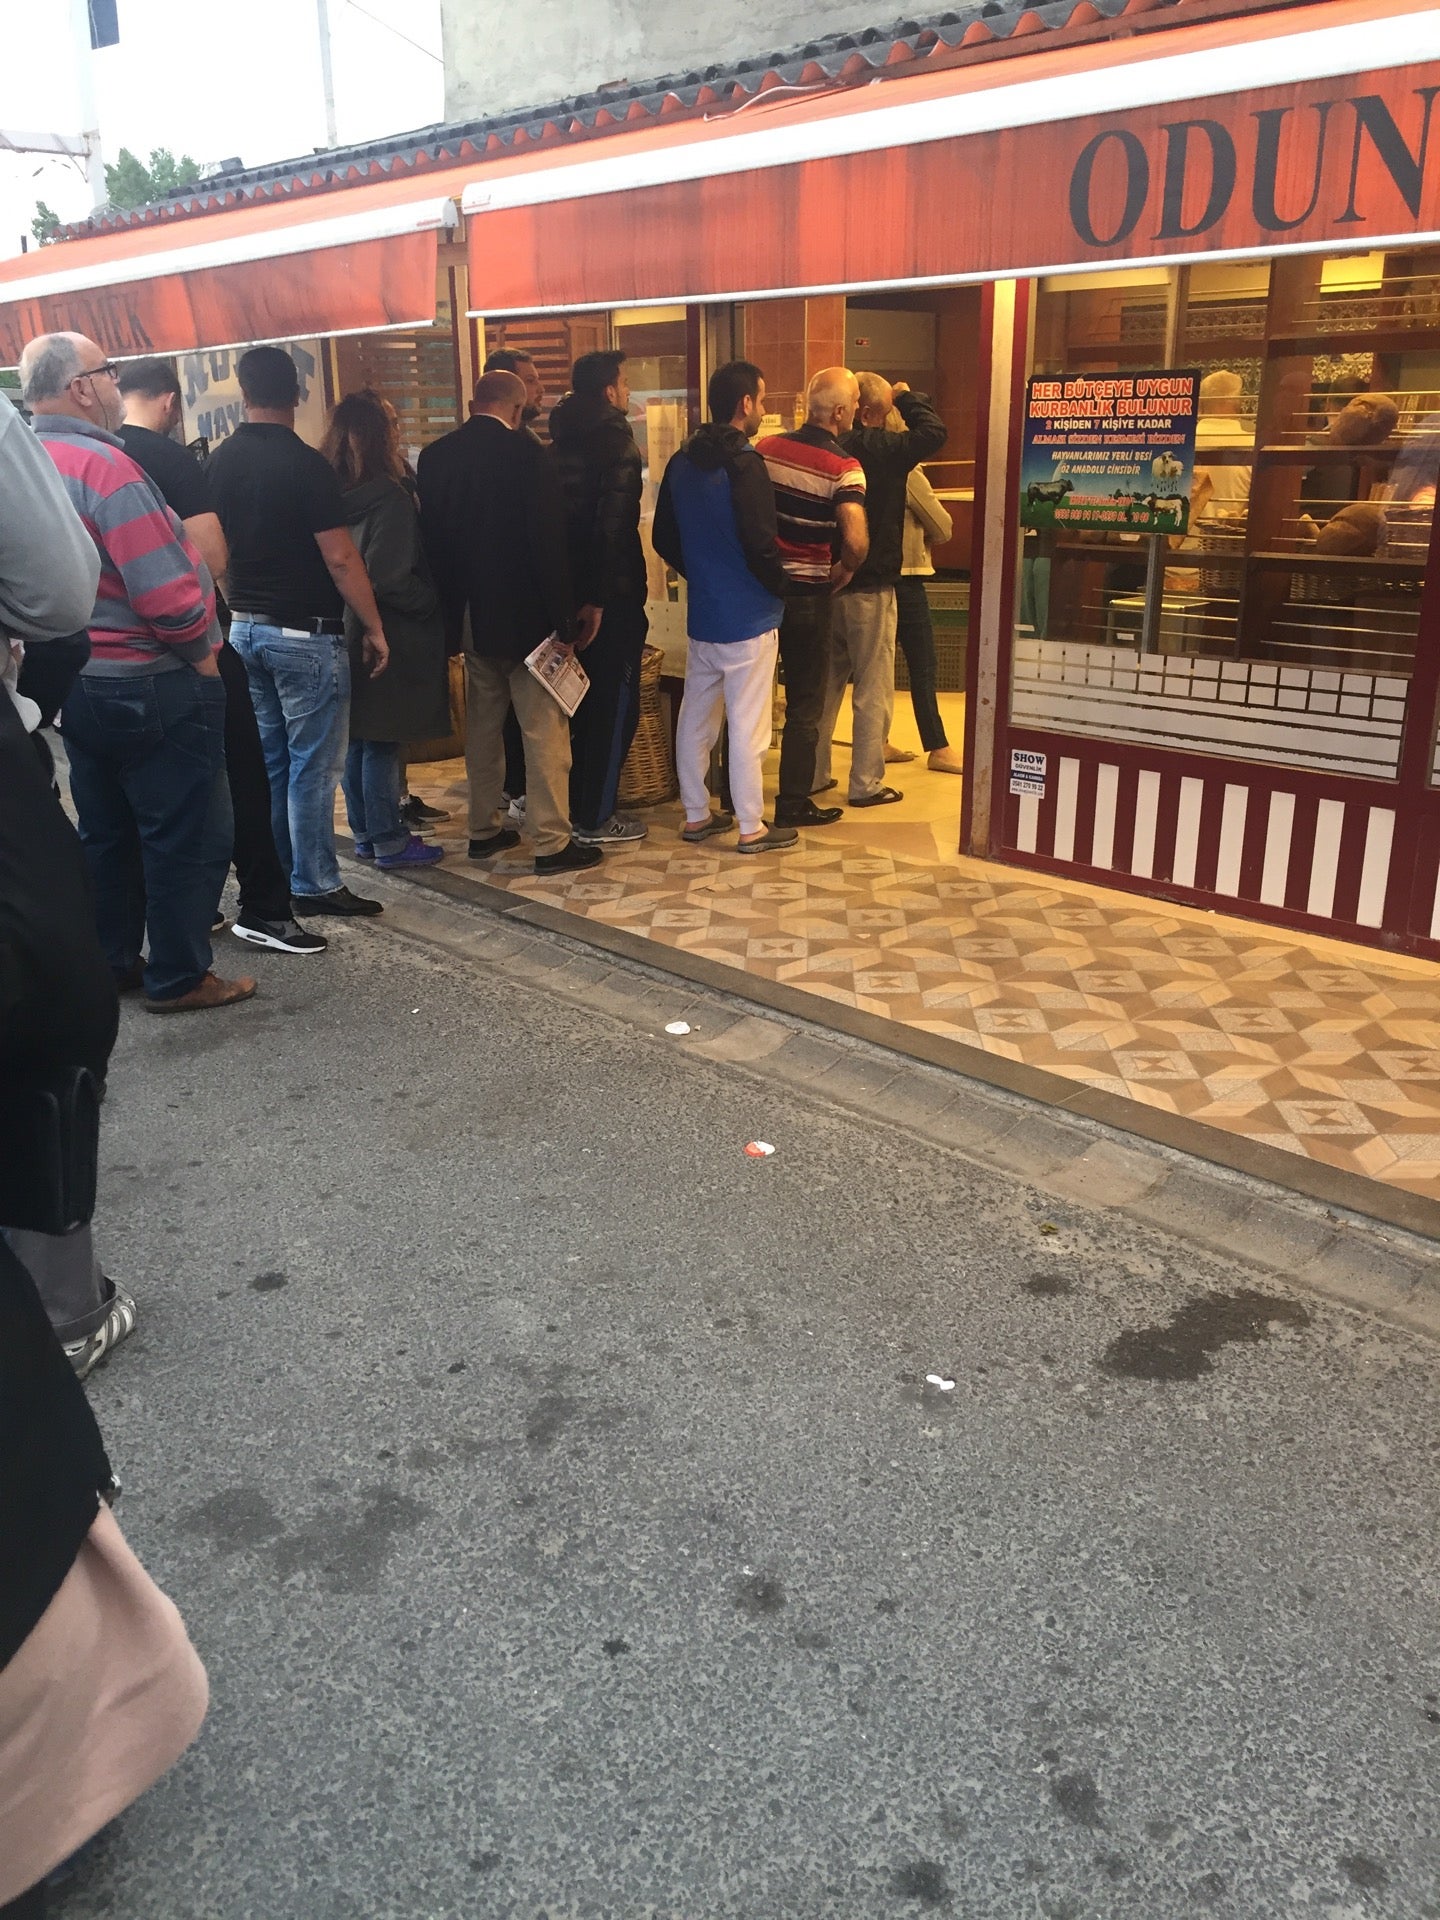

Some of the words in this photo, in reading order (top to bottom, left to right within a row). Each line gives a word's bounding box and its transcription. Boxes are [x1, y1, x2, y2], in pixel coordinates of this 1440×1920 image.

[1069, 87, 1440, 248] ODUN
[1032, 382, 1062, 399] HER
[1064, 378, 1132, 401] BÜTÇEYE
[1137, 378, 1193, 397] UYGUN
[1029, 400, 1114, 418] KURBANLIK
[1116, 398, 1193, 416] BULUNUR
[1045, 420, 1052, 430] 2
[1053, 418, 1091, 431] KİŞİDEN
[1093, 420, 1100, 429] 7
[1102, 417, 1135, 431] KİŞİYE
[1137, 419, 1172, 429] KADAR
[1052, 451, 1110, 461] HAYVANLARIMIZ
[1111, 449, 1133, 460] YERLİ
[1072, 464, 1105, 474] ANADOLU
[1013, 753, 1045, 765] SHOW
